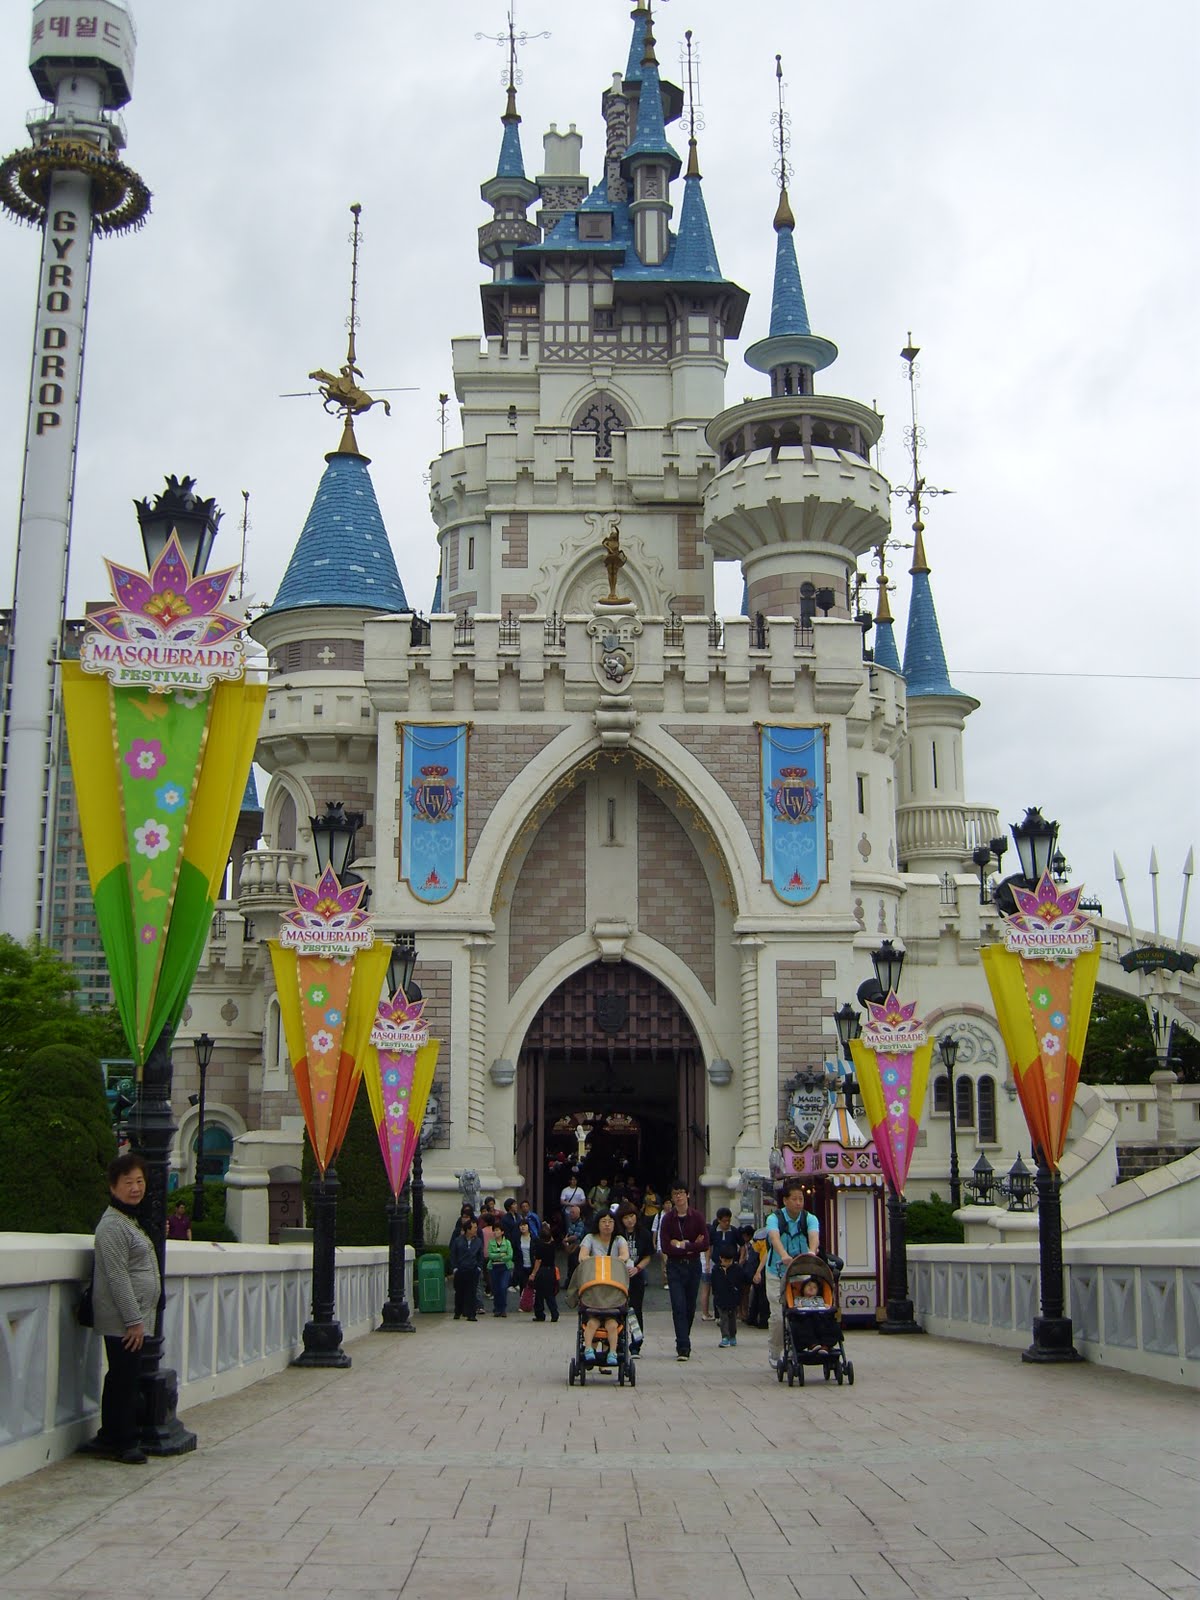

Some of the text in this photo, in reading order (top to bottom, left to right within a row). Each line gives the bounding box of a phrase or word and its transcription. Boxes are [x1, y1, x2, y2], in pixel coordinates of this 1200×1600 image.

[32, 16, 121, 48] 롯데월드
[36, 211, 76, 435] GYRO DROP
[92, 644, 236, 669] MASQUERADE
[119, 669, 203, 684] FESTIVAL
[285, 930, 369, 944] MASQUERADE
[1011, 934, 1089, 947] MASQUERADE
[302, 944, 351, 952] FESTIVAL
[1028, 947, 1073, 955] FESTIVAL
[370, 1031, 426, 1041] MASQUERADE
[866, 1034, 923, 1043] MASQUERADE
[797, 1095, 822, 1103] MAGIC
